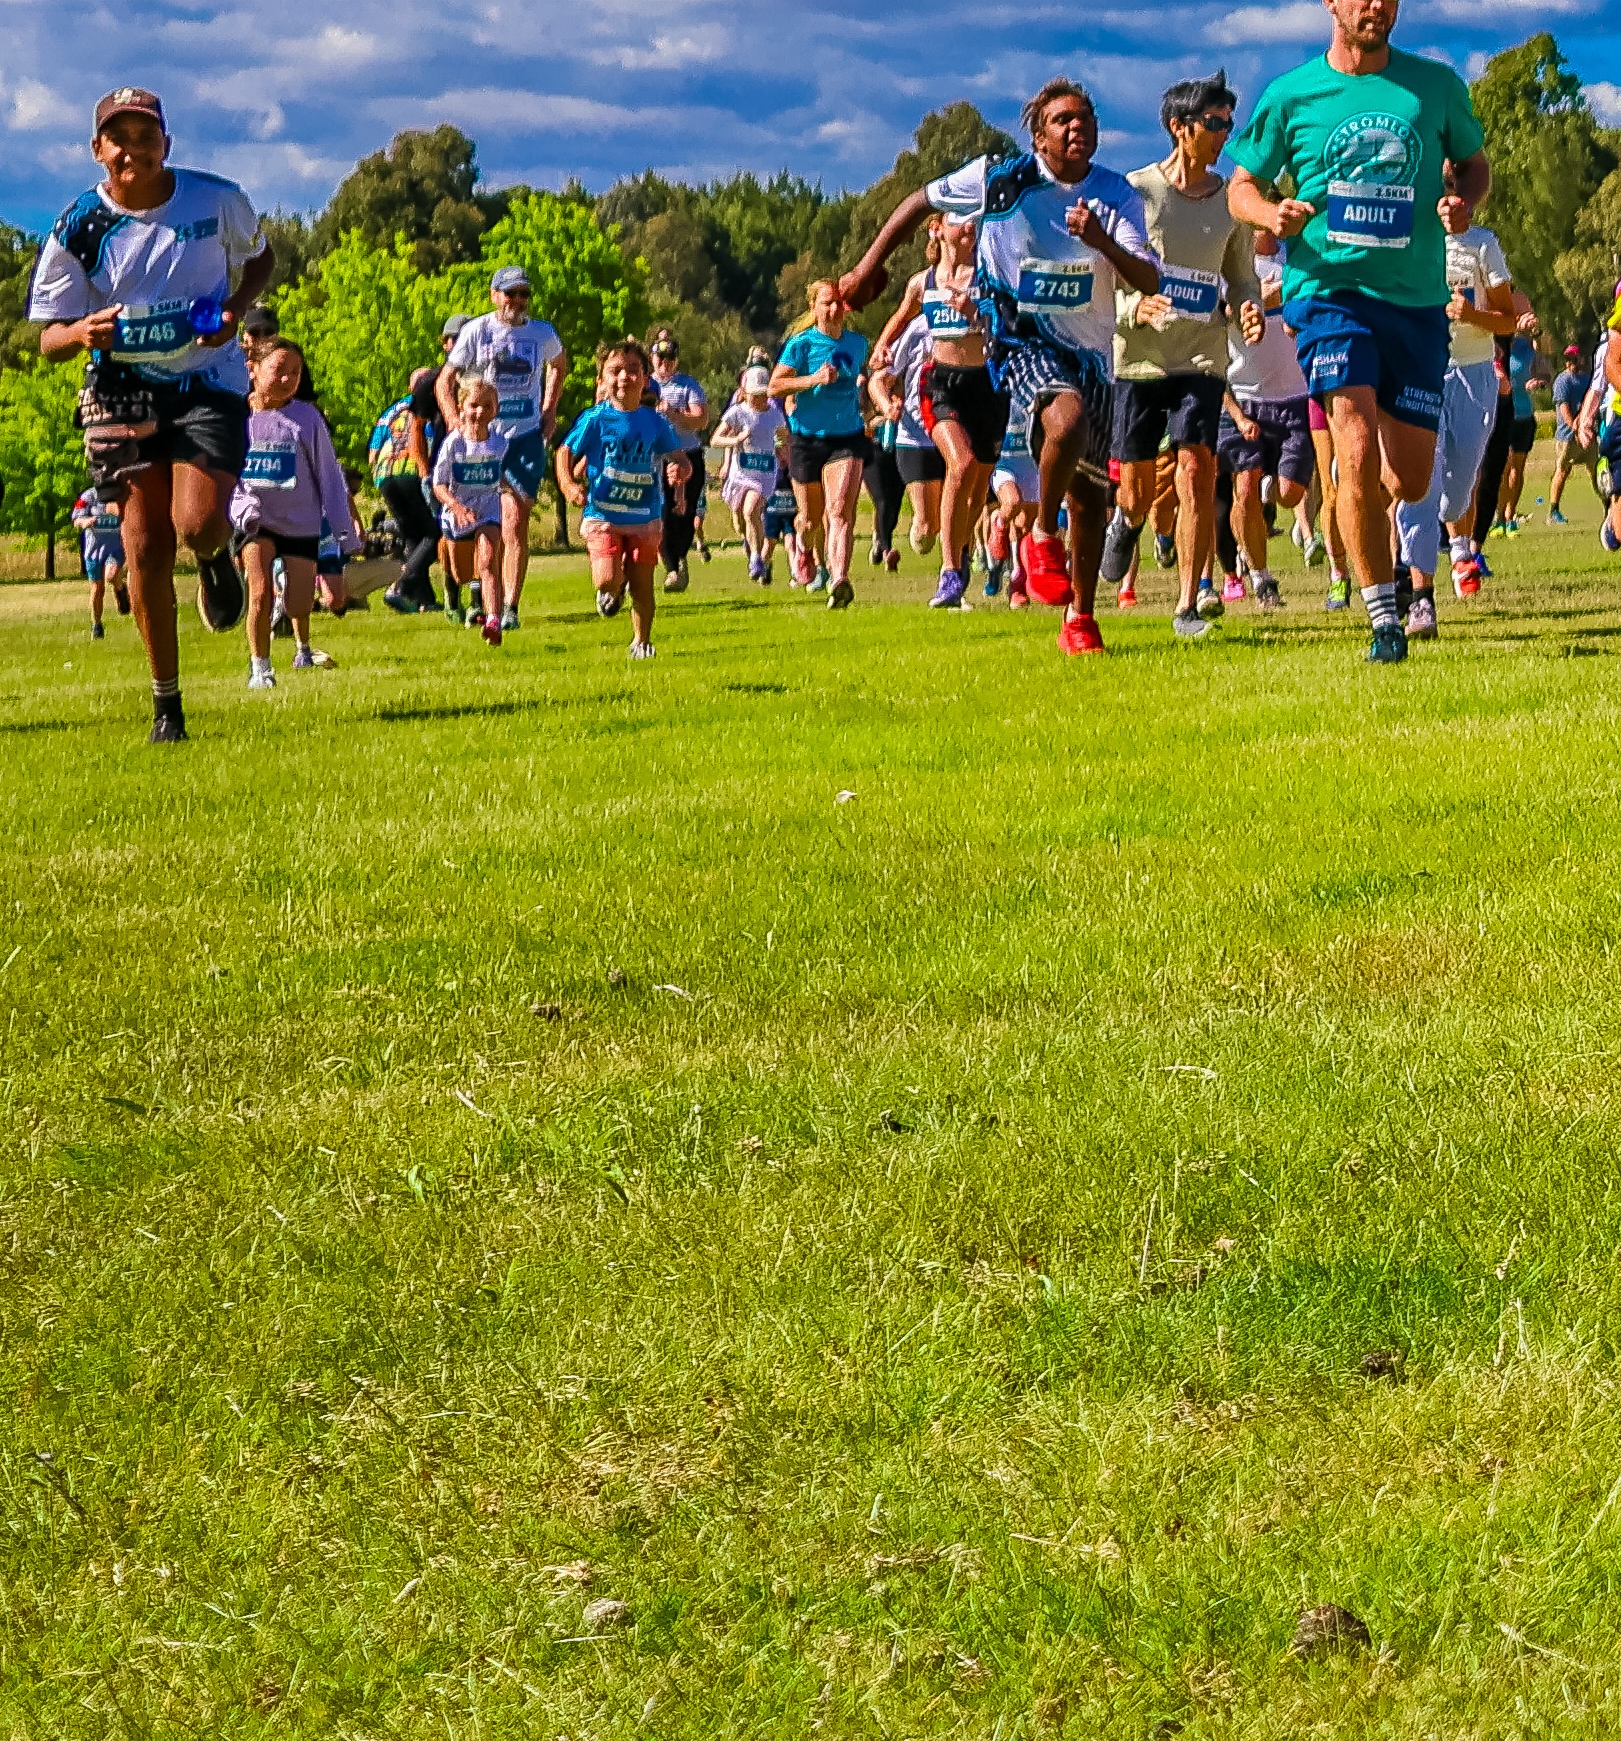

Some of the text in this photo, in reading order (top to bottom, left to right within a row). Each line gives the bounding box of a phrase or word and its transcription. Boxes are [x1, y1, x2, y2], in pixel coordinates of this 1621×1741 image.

[1334, 116, 1411, 146] STROMLO
[1343, 204, 1397, 224] ADULT
[1034, 279, 1080, 298] 2743
[1162, 283, 1203, 302] ADULT
